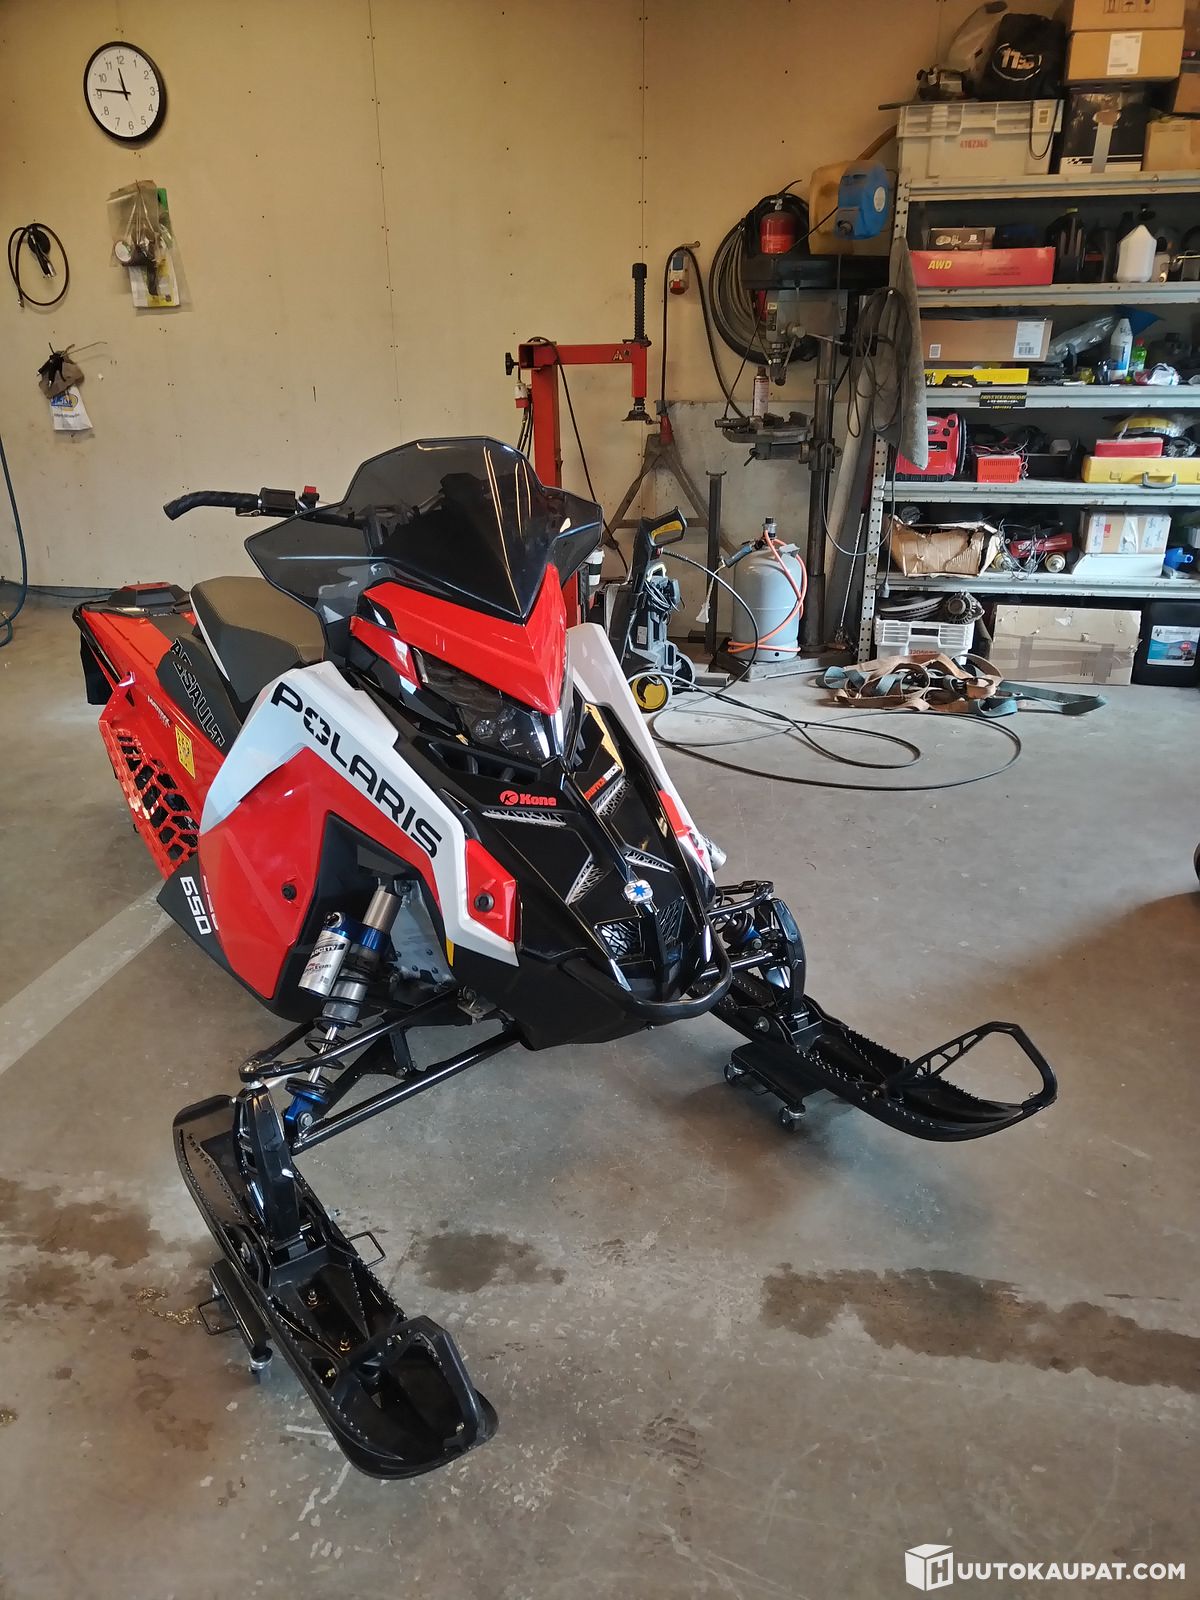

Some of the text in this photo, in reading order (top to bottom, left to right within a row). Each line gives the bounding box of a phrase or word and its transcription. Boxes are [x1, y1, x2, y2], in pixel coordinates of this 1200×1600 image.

[116, 55, 125, 65] 12
[105, 61, 113, 71] 11
[98, 73, 107, 83] 10
[144, 70, 149, 80] 2
[96, 90, 103, 99] 9
[149, 86, 156, 96] 3
[104, 106, 109, 116] 8
[148, 103, 154, 113] 4
[115, 117, 120, 127] 7
[128, 120, 134, 130] 6
[141, 116, 146, 125] 5
[928, 260, 952, 270] AWD
[169, 637, 226, 748] ASSAULT
[271, 681, 443, 858] POLARIS
[180, 876, 212, 935] 650
